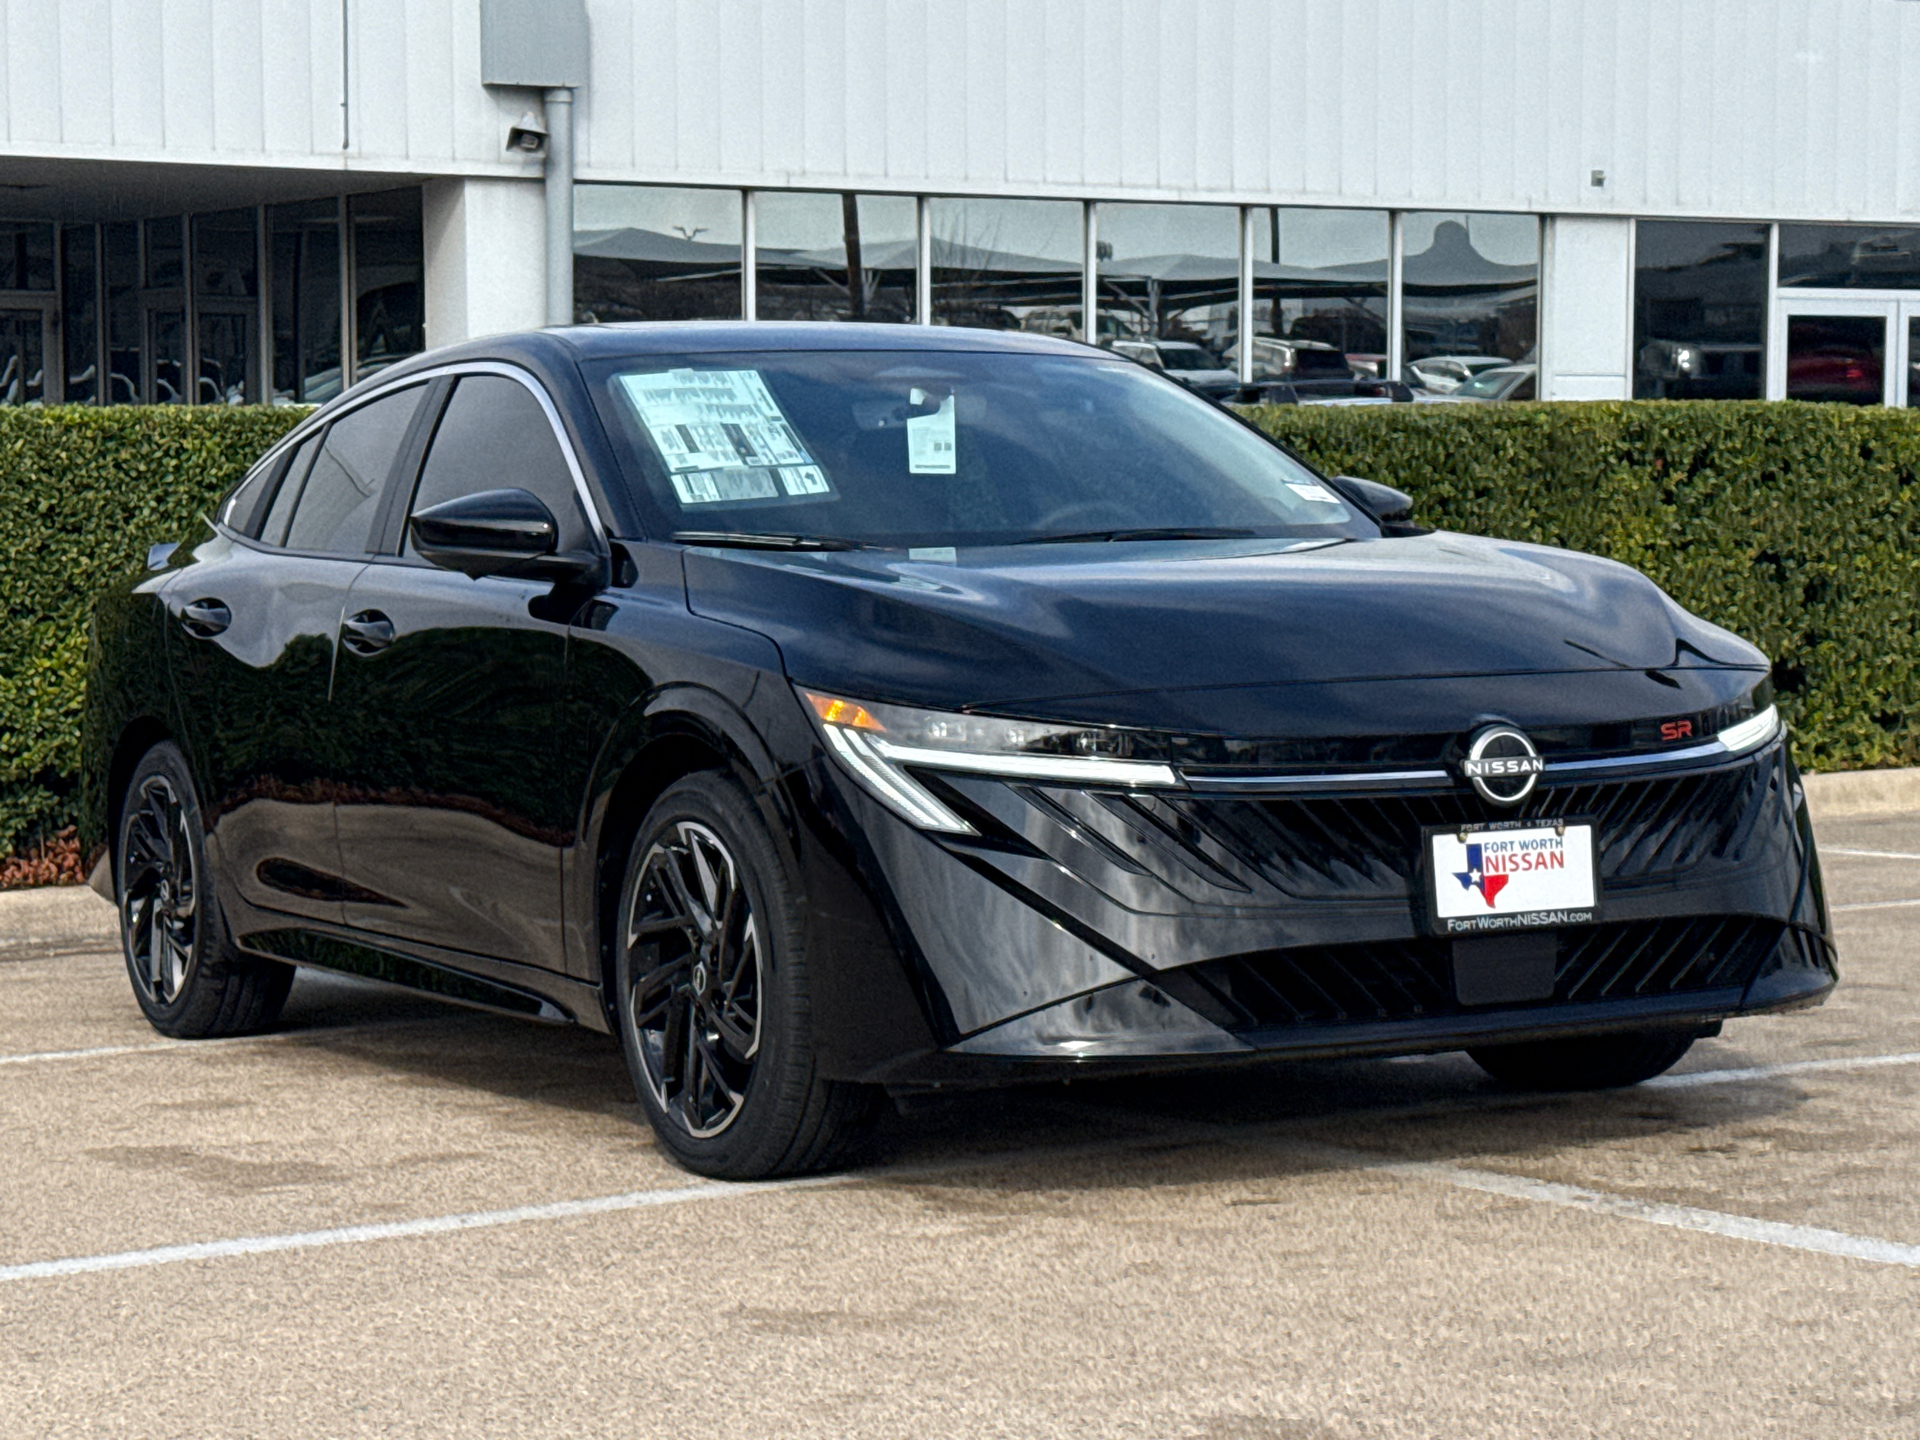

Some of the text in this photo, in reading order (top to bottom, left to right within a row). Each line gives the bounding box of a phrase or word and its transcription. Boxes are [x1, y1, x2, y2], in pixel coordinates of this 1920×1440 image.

[1660, 720, 1692, 741] SR
[1466, 759, 1544, 775] NISSAN
[1461, 818, 1564, 832] FORT WORTH TEXAS
[1484, 838, 1563, 853] FORT WORTH
[1484, 850, 1564, 873] NISSAN
